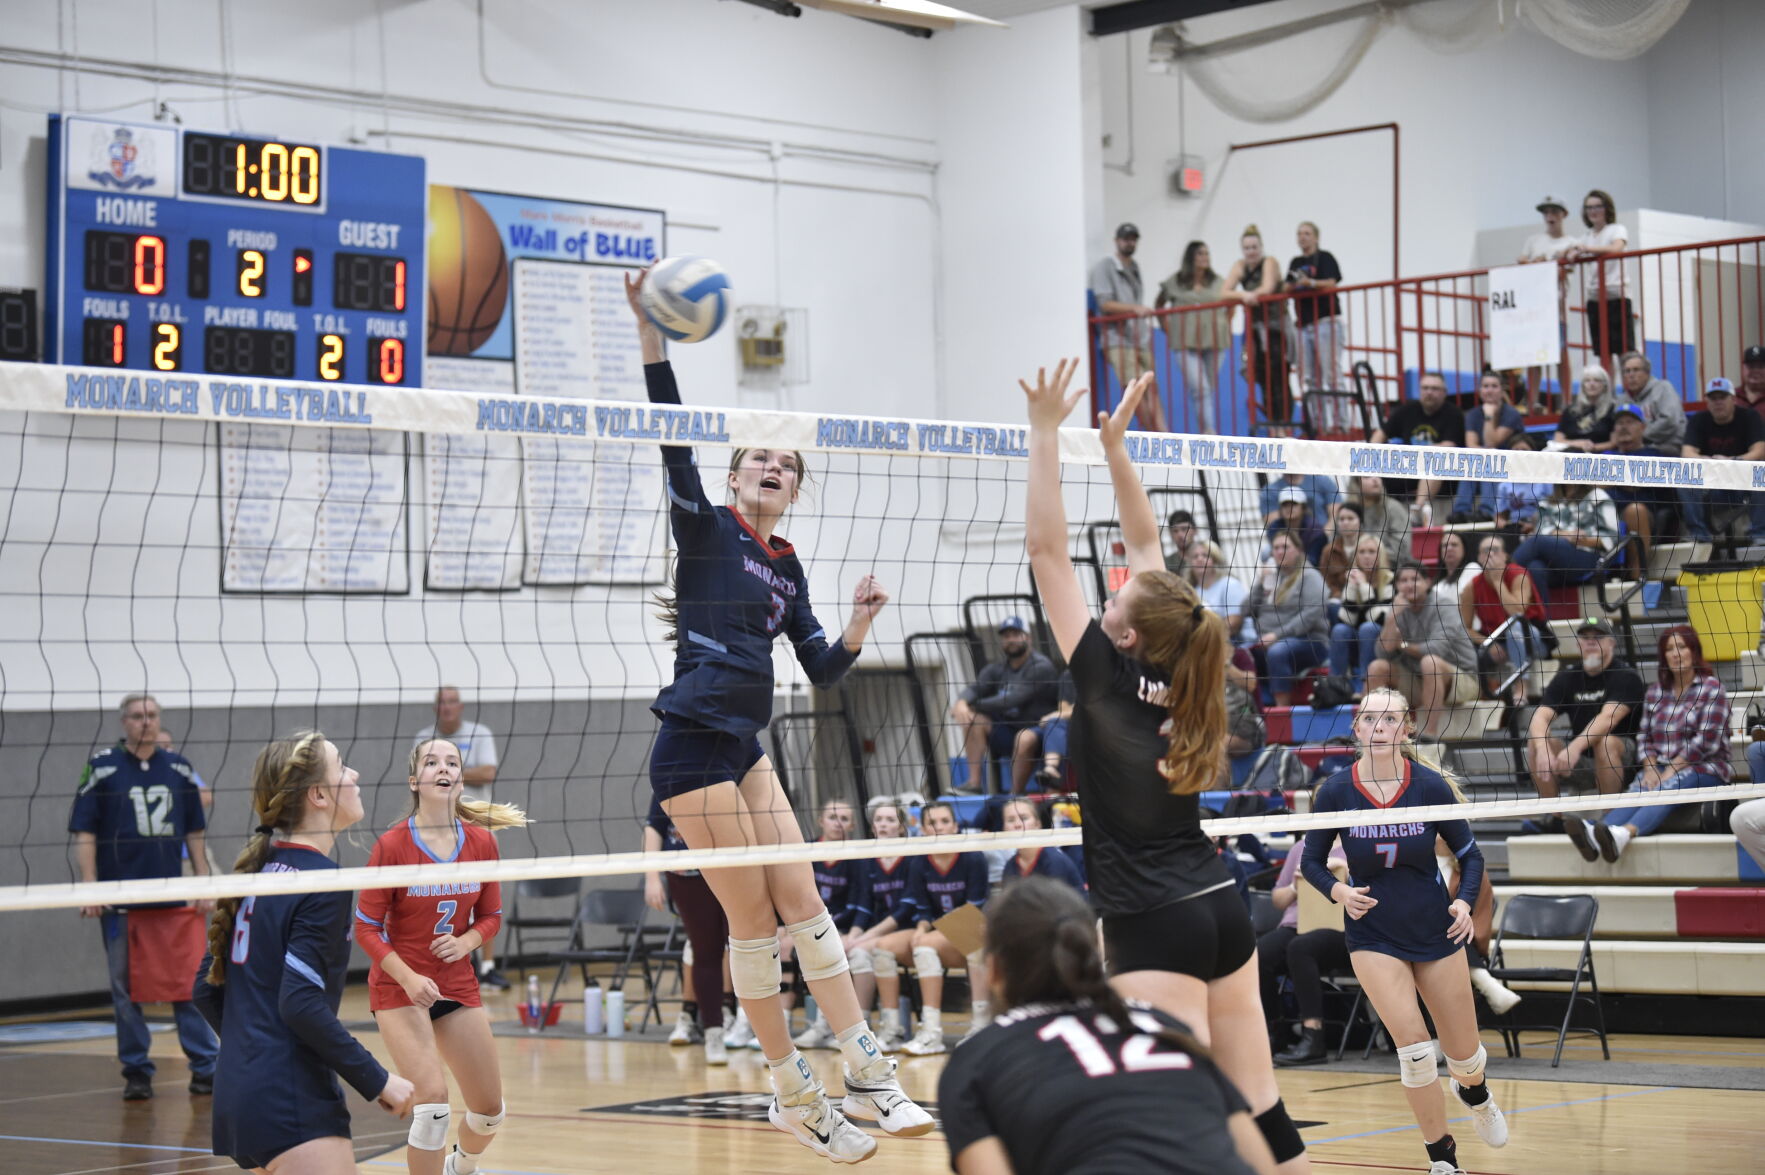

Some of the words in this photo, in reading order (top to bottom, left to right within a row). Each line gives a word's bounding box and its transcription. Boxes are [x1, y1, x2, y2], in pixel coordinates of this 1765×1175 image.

[236, 143, 319, 204] 1:00
[96, 198, 157, 227] HOME
[227, 229, 277, 250] PERIOD
[339, 219, 401, 249] GUEST
[509, 224, 557, 252] Wall
[565, 231, 588, 262] of
[596, 232, 657, 261] BLUE
[135, 235, 164, 295] 0
[240, 250, 264, 297] 2
[394, 260, 405, 311] 1
[83, 297, 130, 319] FOULS
[148, 302, 189, 324] T.O.L.
[204, 305, 258, 328] PLAYER
[264, 310, 299, 331] FOUL
[313, 313, 351, 335] T.O.L.
[113, 324, 123, 364] 1
[155, 323, 179, 370] 2
[366, 317, 408, 338] FOULS
[319, 334, 343, 380] 2
[380, 338, 404, 384] 0
[65, 373, 199, 415] MONARCH
[209, 382, 372, 424] VOLLEYBALL
[476, 399, 587, 436] MONARCH
[594, 406, 729, 442] VOLLEYBALL
[816, 418, 910, 450] MONARCH
[916, 423, 1029, 457] VOLLEYBALL
[1188, 440, 1287, 469] VOLLEYBALL
[1350, 447, 1419, 475] MONARCH
[1423, 451, 1509, 479] VOLLEYBALL
[1563, 457, 1625, 482] MONARCH
[1629, 460, 1704, 486] VOLLEYBALL
[128, 784, 175, 837] 12
[1348, 822, 1425, 839] MONARCHS
[1375, 842, 1399, 870] 7
[231, 893, 256, 965] 6
[433, 899, 458, 935] 2
[1036, 1003, 1195, 1077] 12
